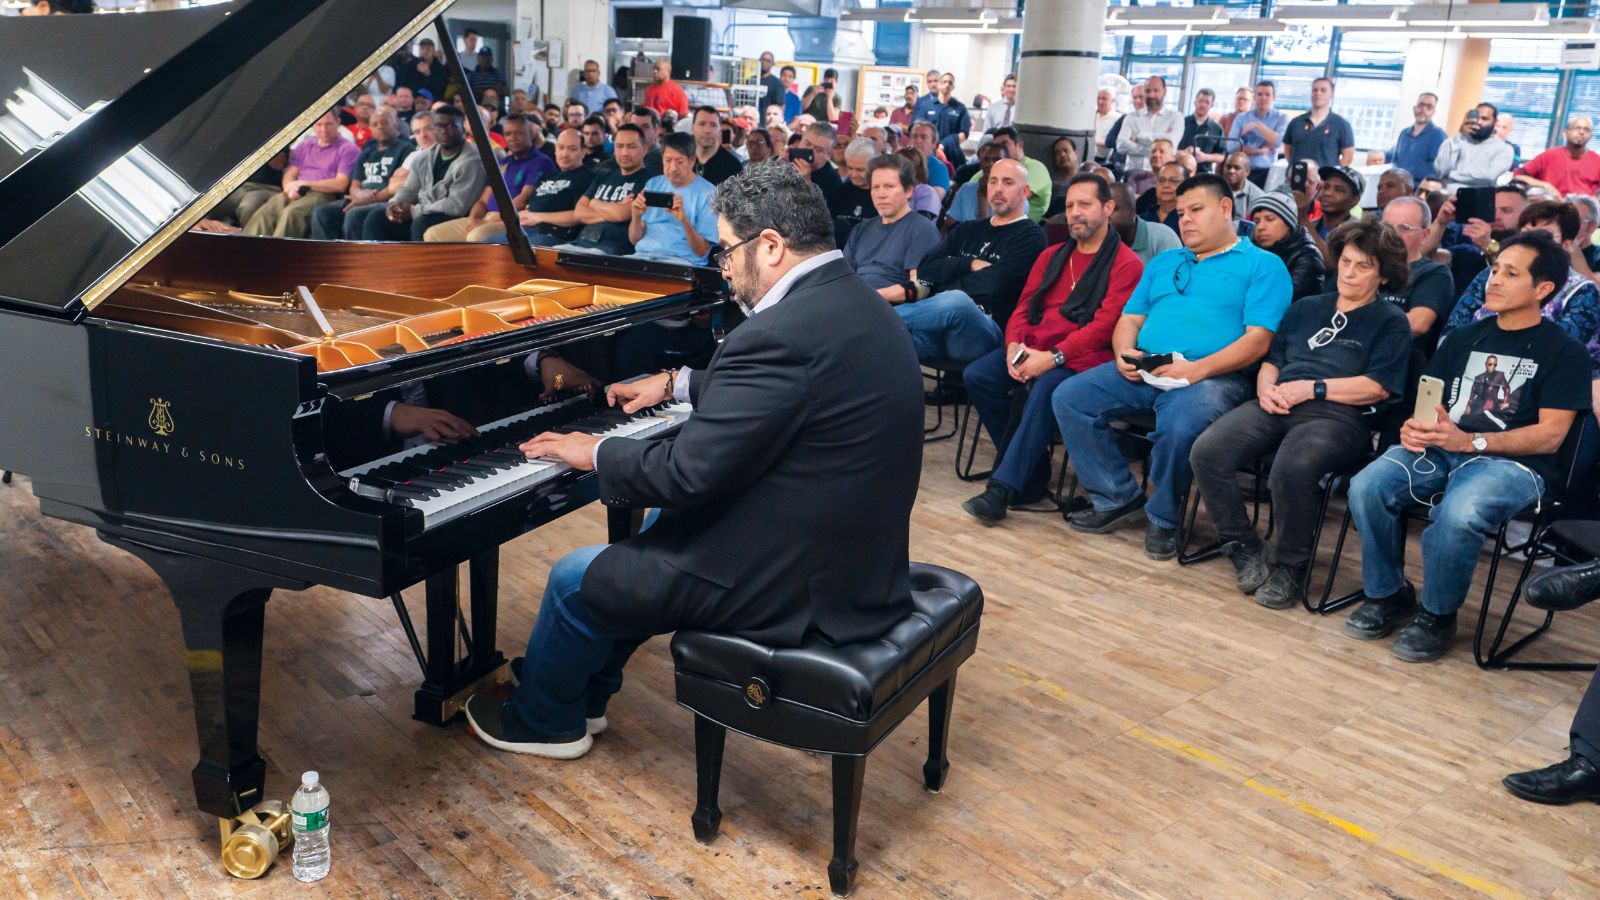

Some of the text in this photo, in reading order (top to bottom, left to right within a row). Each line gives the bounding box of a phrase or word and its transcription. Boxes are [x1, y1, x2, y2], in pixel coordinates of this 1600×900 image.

[85, 426, 245, 470] STEINWAY & SONS
